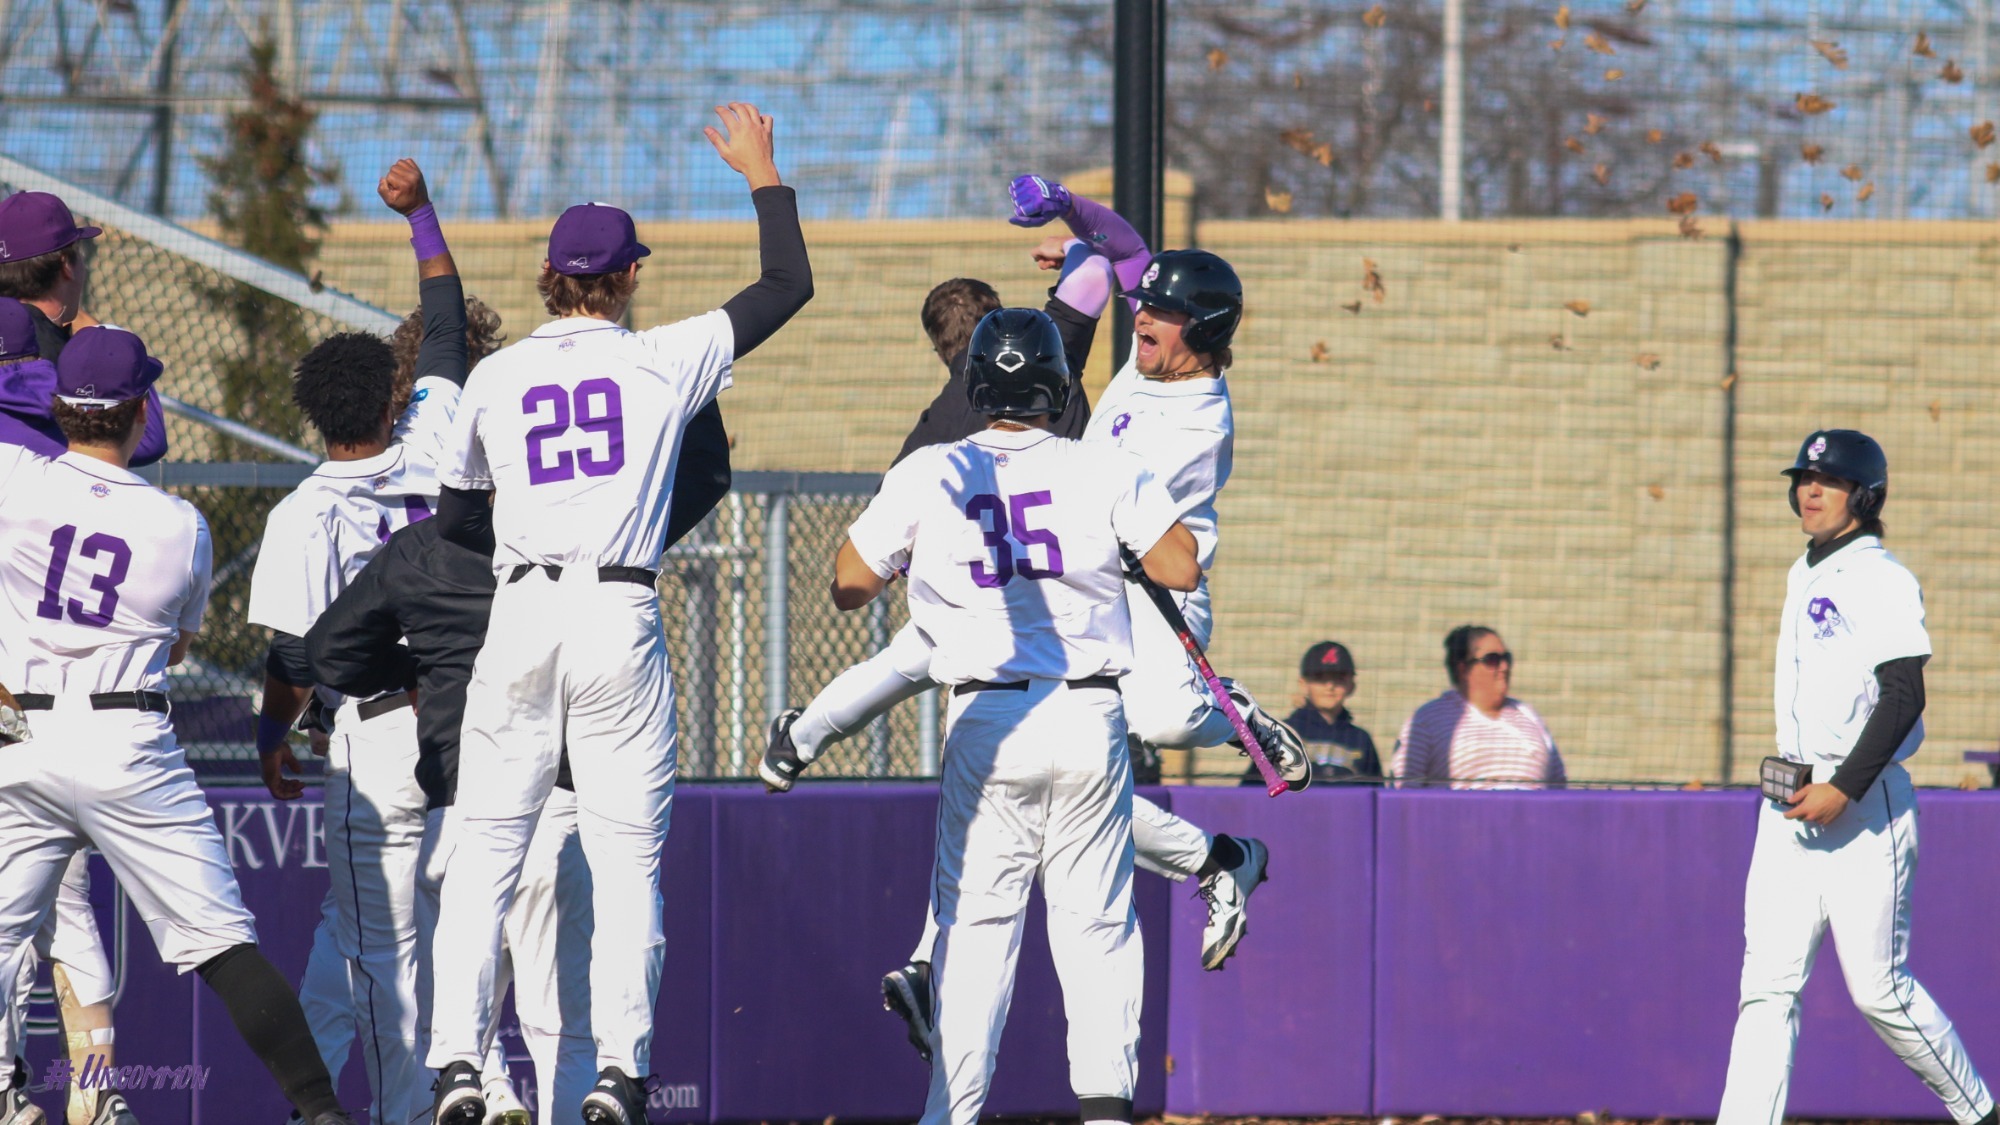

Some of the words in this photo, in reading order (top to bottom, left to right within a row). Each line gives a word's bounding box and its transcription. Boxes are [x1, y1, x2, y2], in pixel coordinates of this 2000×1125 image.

[521, 377, 625, 486] 29
[36, 524, 132, 628] 13
[965, 490, 1064, 588] 35
